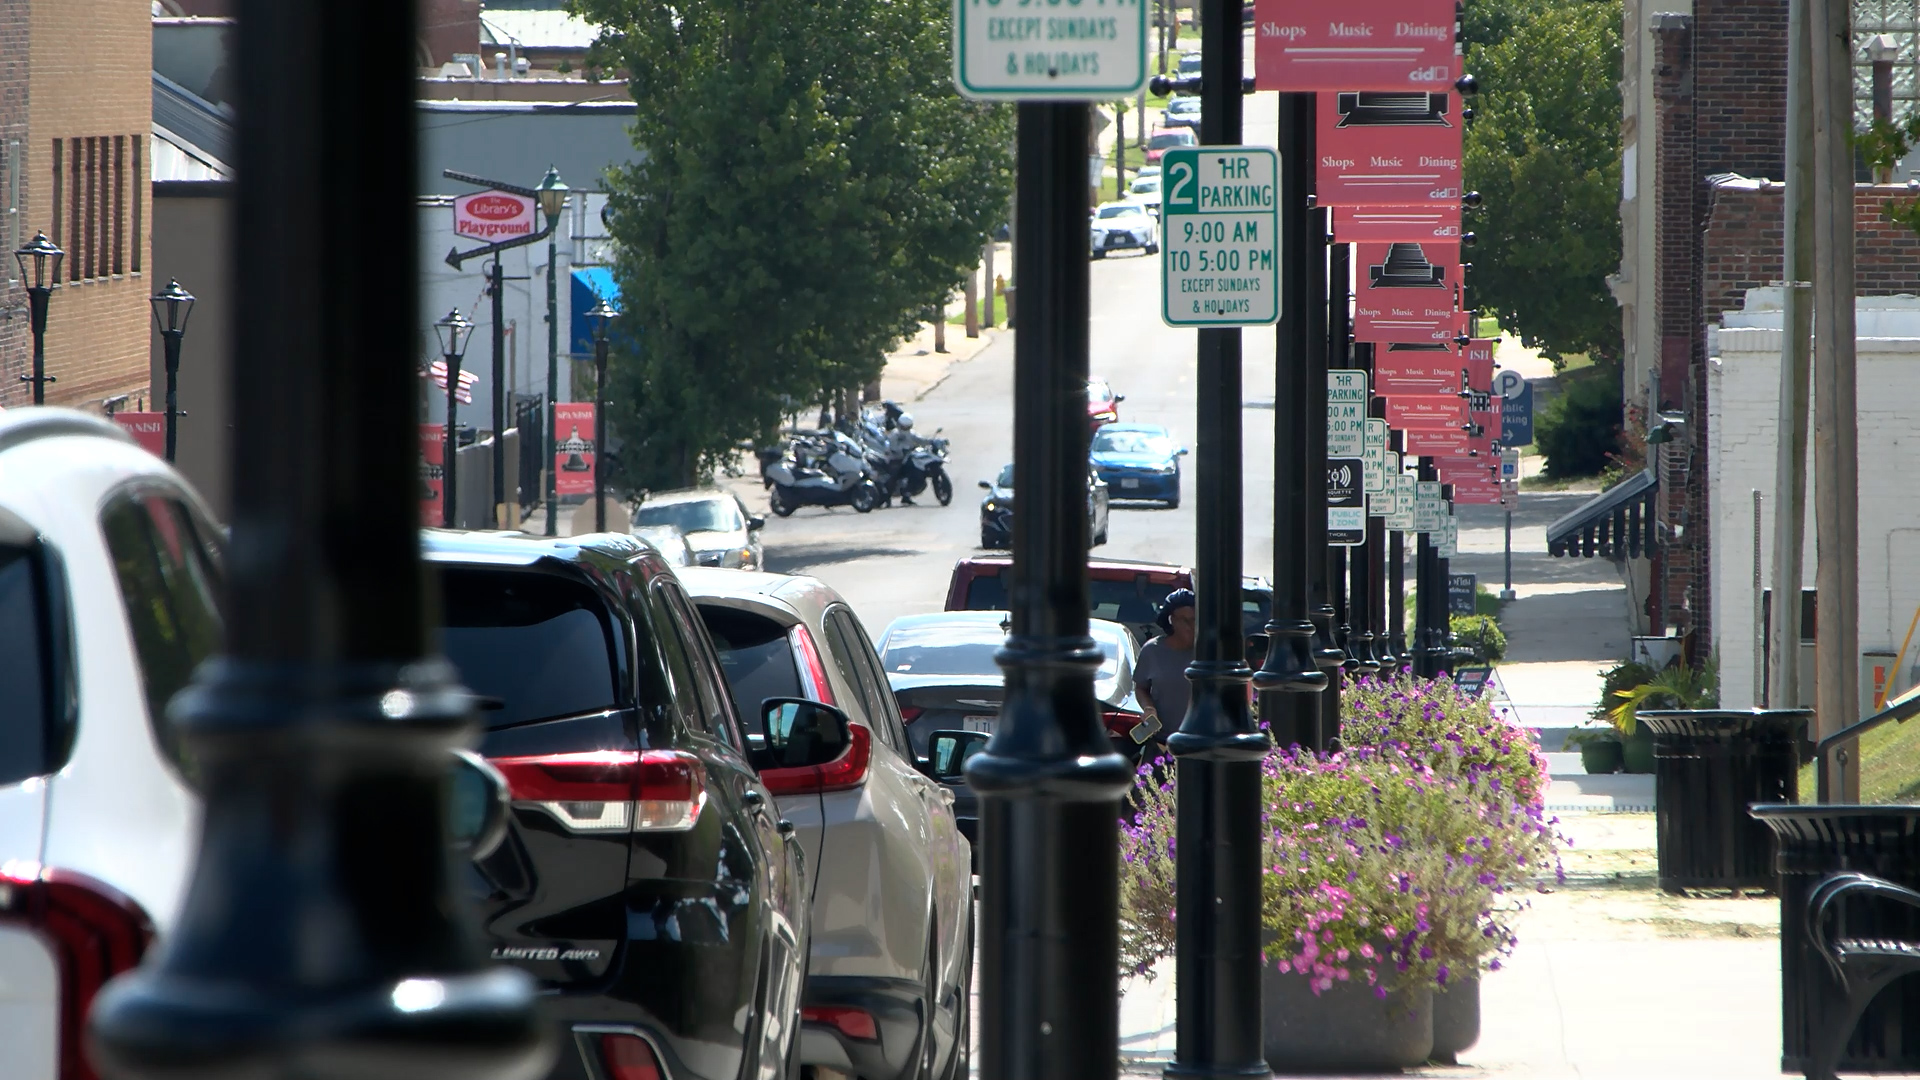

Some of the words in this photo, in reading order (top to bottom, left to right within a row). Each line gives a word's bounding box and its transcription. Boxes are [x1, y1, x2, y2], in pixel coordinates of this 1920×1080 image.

[988, 16, 1041, 40] EXCEPT
[1047, 16, 1117, 40] SUNDAYS
[1261, 22, 1307, 41] Shops
[1329, 22, 1374, 36] Music
[1395, 22, 1448, 41] Dining
[1006, 51, 1019, 75] &
[1024, 51, 1099, 75] HOLIDAYS
[1409, 66, 1435, 81] cid
[1322, 156, 1355, 170] Shops
[1370, 156, 1403, 167] Music
[1419, 156, 1457, 170] Dining
[1169, 161, 1194, 205] 2
[1222, 158, 1250, 179] HR
[1201, 185, 1272, 207] PARKING
[1429, 188, 1448, 198] cid
[473, 203, 518, 214] Library's
[459, 220, 530, 236] Playground
[1184, 221, 1225, 243] 9:00
[1233, 221, 1257, 242] AM
[1433, 227, 1449, 236] cid
[1170, 250, 1190, 271] TO
[1199, 250, 1240, 271] 5:00
[1249, 249, 1272, 271] PM
[1181, 278, 1214, 292] EXCEPT
[1217, 278, 1260, 292] SUNDAYS
[1192, 300, 1200, 313] &
[1204, 299, 1250, 314] HOLIDAYS
[1359, 308, 1381, 317] Shops
[1392, 308, 1414, 316] Music
[1425, 308, 1451, 318] Dining
[1378, 368, 1397, 376] Shops
[1433, 368, 1455, 377] Dining
[1338, 376, 1352, 386] HR
[1343, 406, 1355, 417] AM
[1440, 404, 1459, 412] Dining
[1350, 420, 1362, 431] PM
[1366, 435, 1383, 443] KING
[1366, 450, 1377, 458] AM
[1372, 461, 1383, 470] PM
[491, 947, 559, 960] LIMITED
[560, 949, 600, 960] AWD
